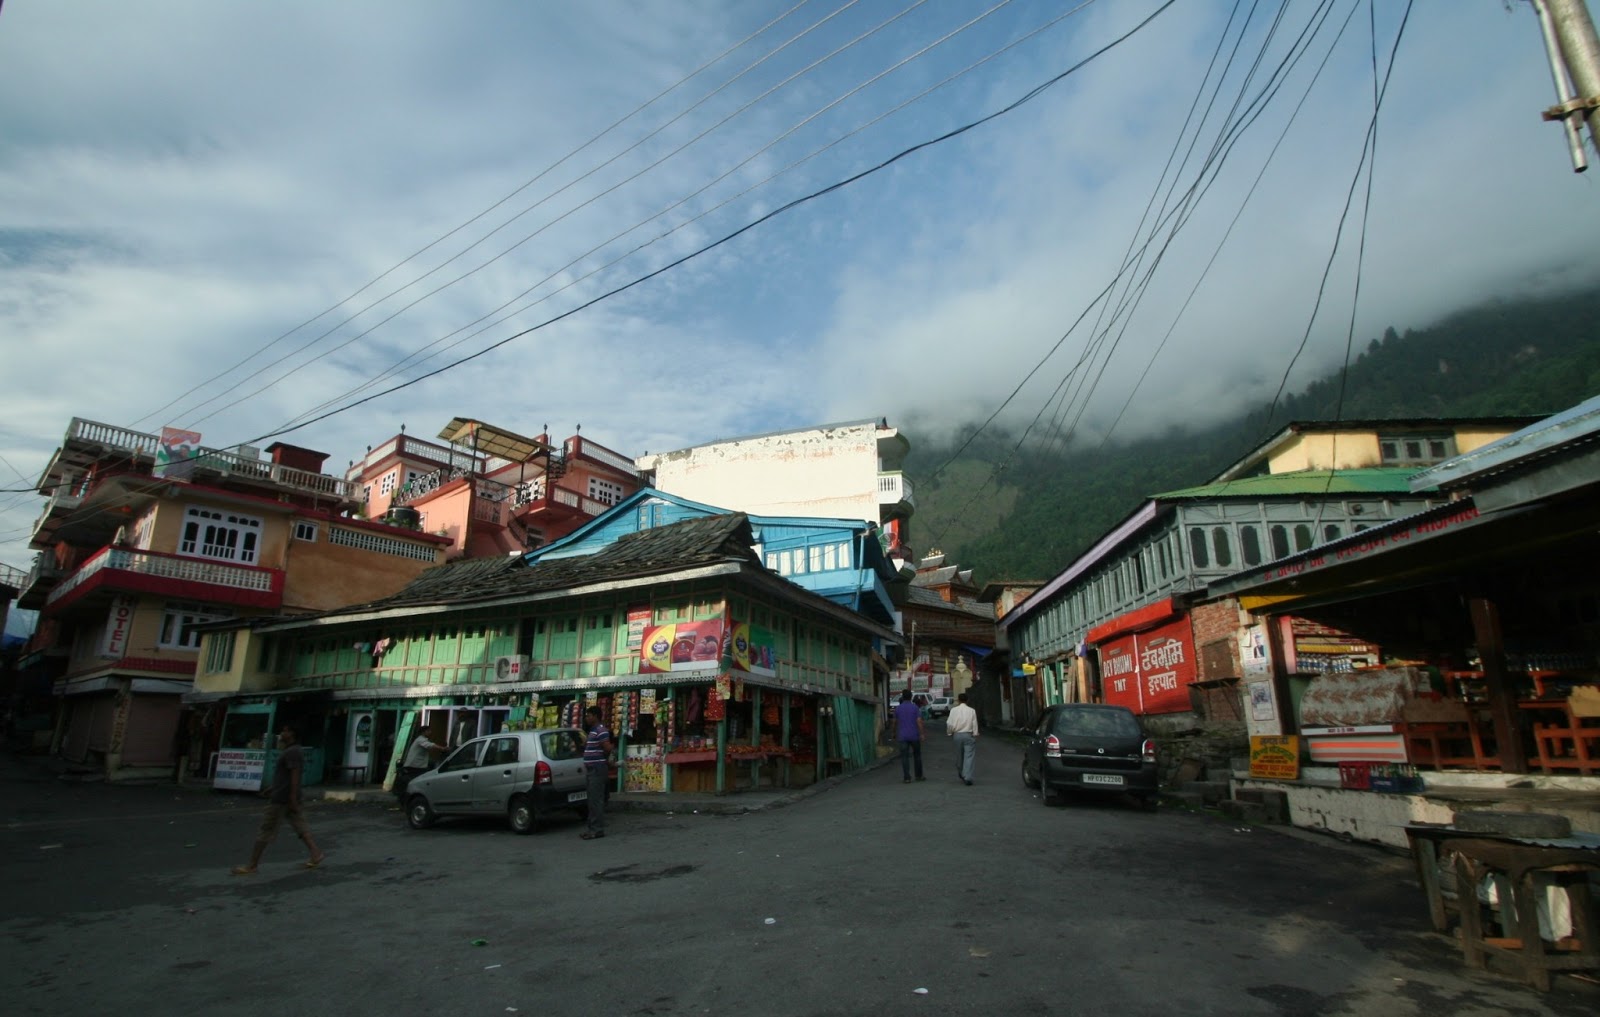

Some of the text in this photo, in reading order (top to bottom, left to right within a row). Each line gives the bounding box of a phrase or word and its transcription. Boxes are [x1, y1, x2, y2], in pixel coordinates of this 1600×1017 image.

[109, 596, 132, 653] HOTEL
[1113, 653, 1133, 676] BHUMI
[1141, 638, 1184, 671] देवभूमि
[1114, 678, 1126, 692] TMT
[1148, 670, 1177, 696] इस्पात
